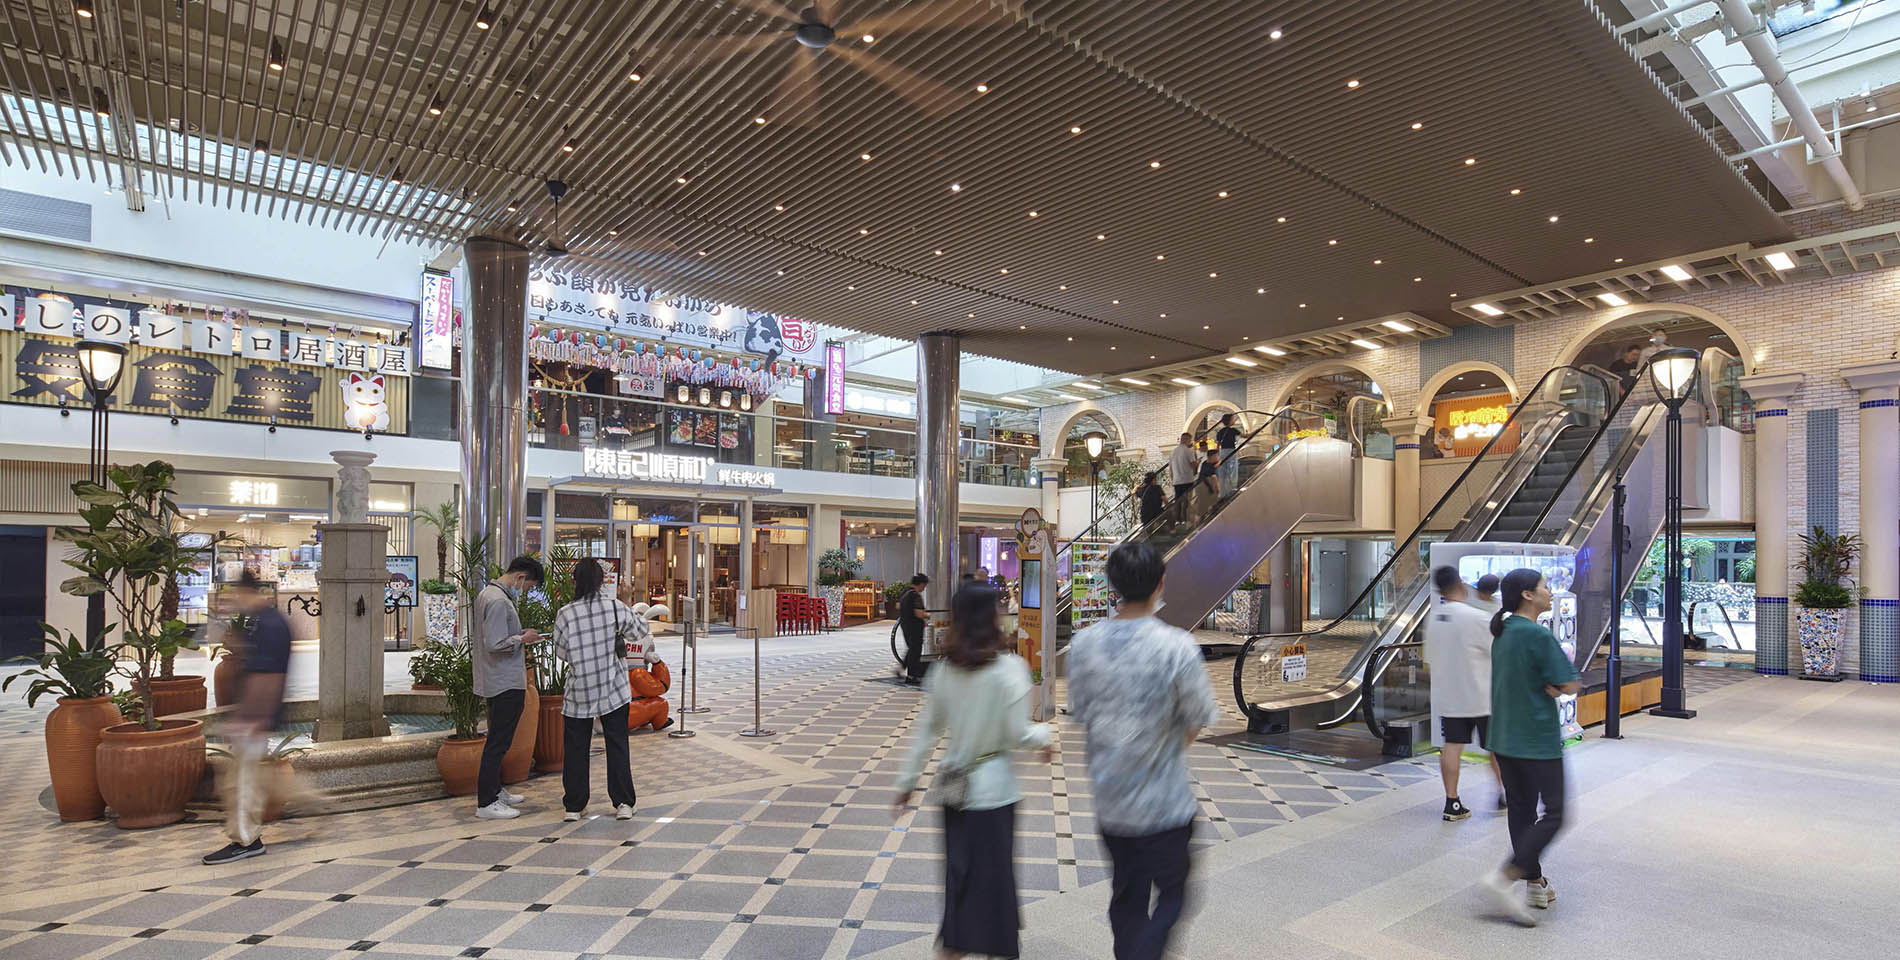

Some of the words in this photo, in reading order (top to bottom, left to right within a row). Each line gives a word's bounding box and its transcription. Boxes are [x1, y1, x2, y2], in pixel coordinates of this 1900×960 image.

[0, 303, 407, 373] しのレトロ居酒屋
[584, 447, 707, 481] 陳記順和
